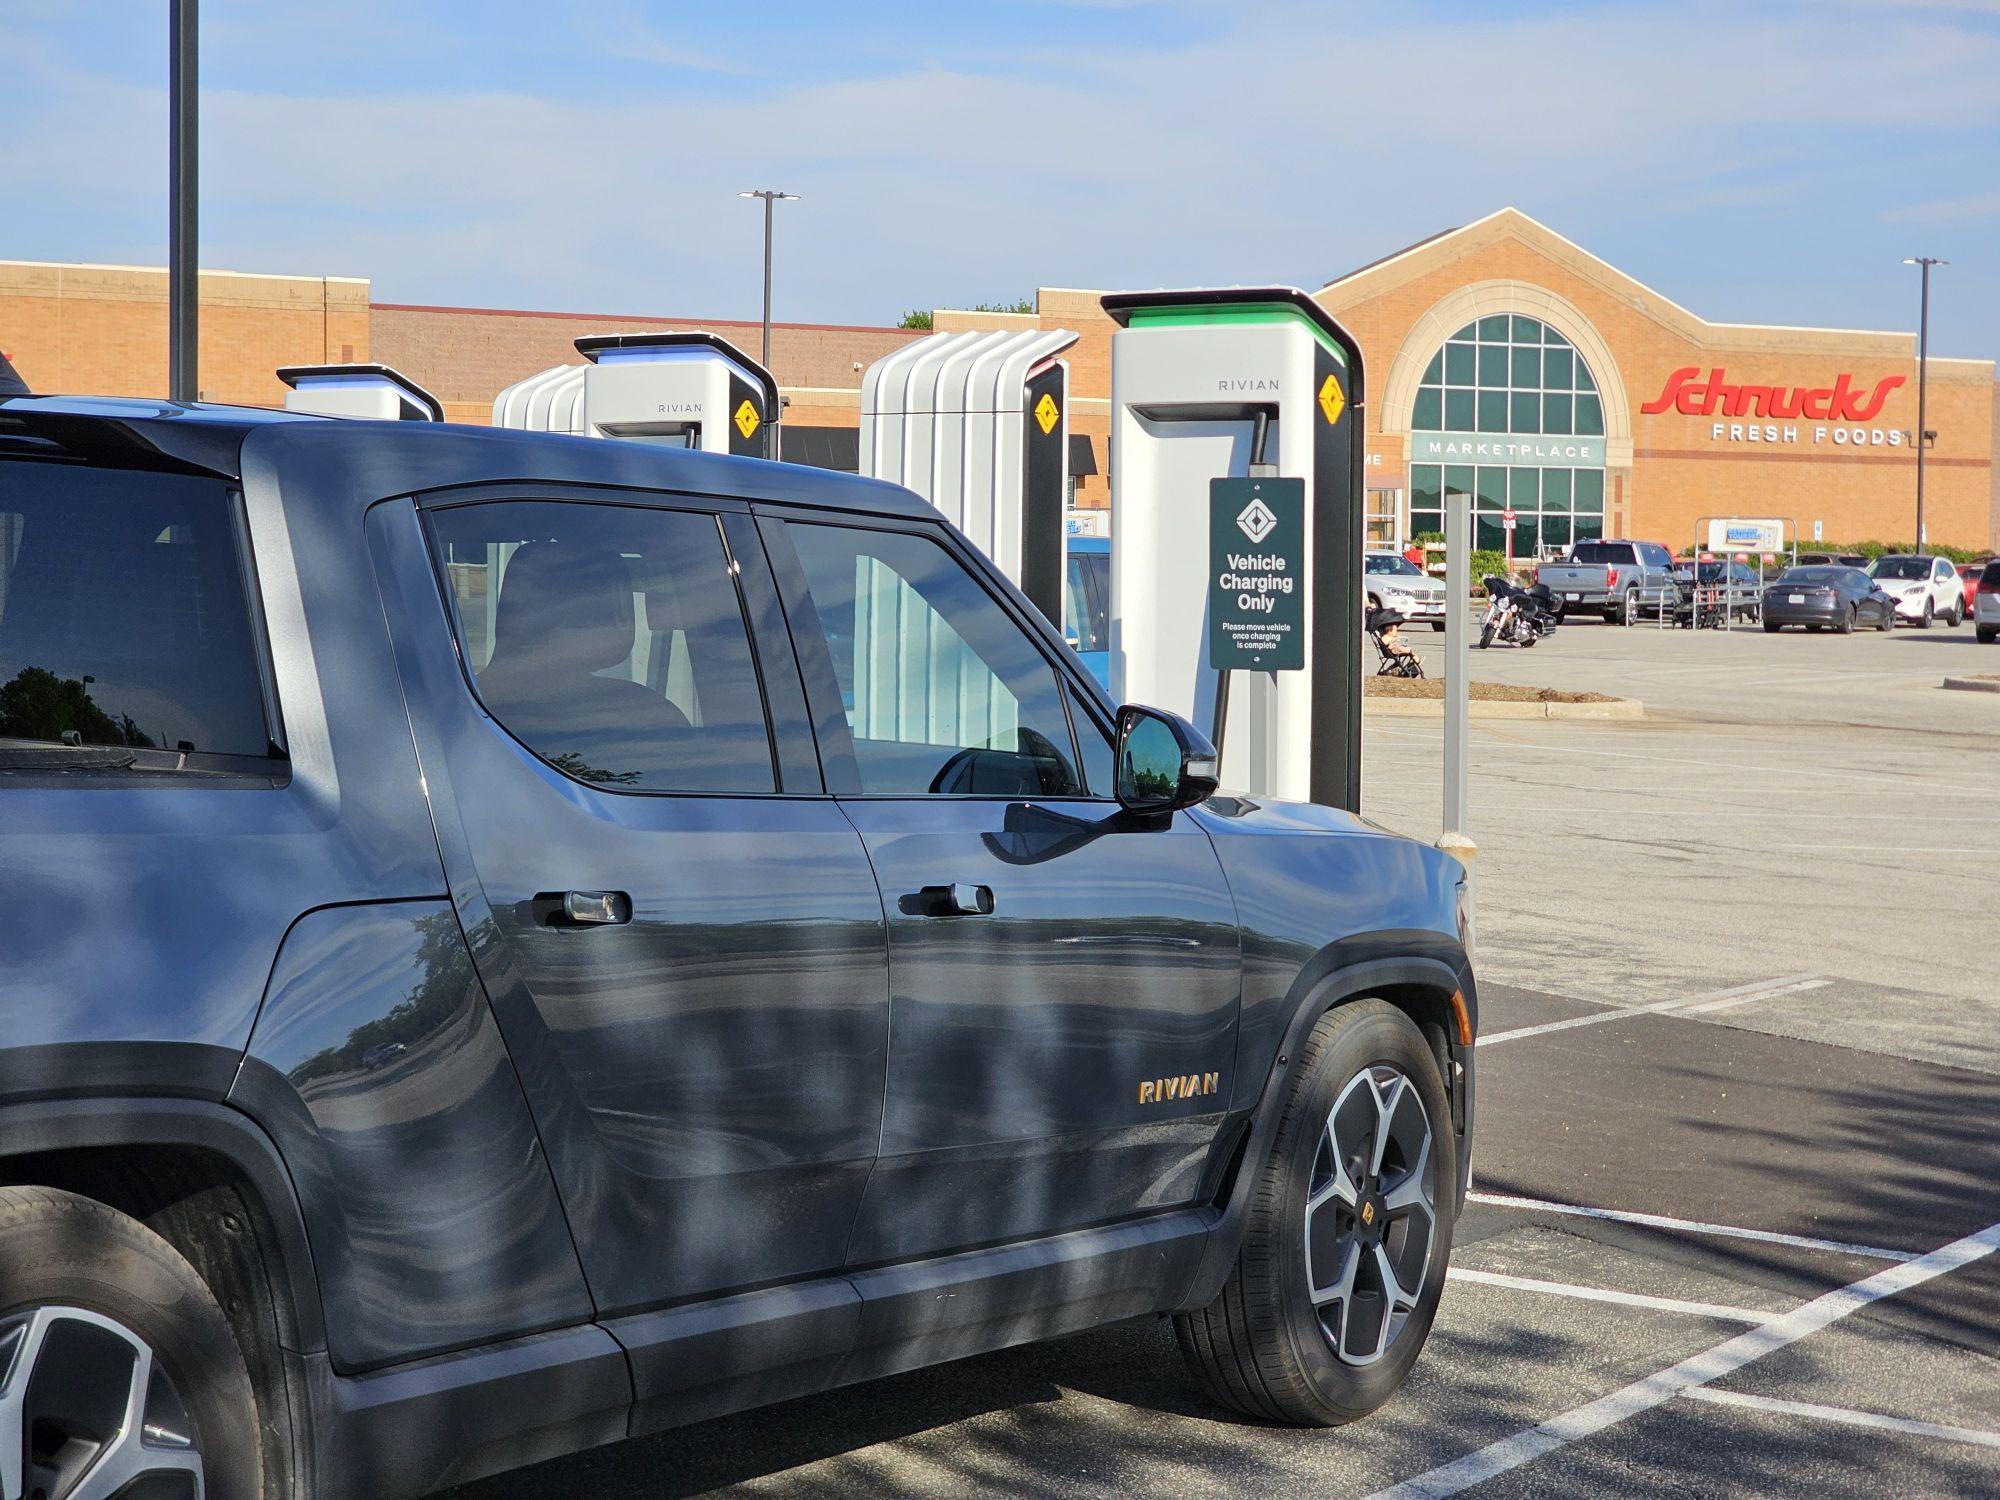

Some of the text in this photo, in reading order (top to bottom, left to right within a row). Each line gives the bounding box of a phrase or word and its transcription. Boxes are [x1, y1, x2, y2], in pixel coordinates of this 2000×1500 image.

[1218, 380, 1279, 391] RIVIAN
[658, 404, 702, 413] RIVIAN
[1711, 423, 1901, 446] FRESH FOODS
[1429, 442, 1590, 458] MARKETPLACE
[1227, 554, 1286, 571] Vehicle
[1220, 573, 1293, 594] Charging
[1237, 593, 1275, 614] Only
[1222, 622, 1291, 632] Please move vehicle
[1250, 632, 1281, 642] charging
[1236, 641, 1277, 650] is complete
[1138, 1071, 1219, 1105] RIVIAN
